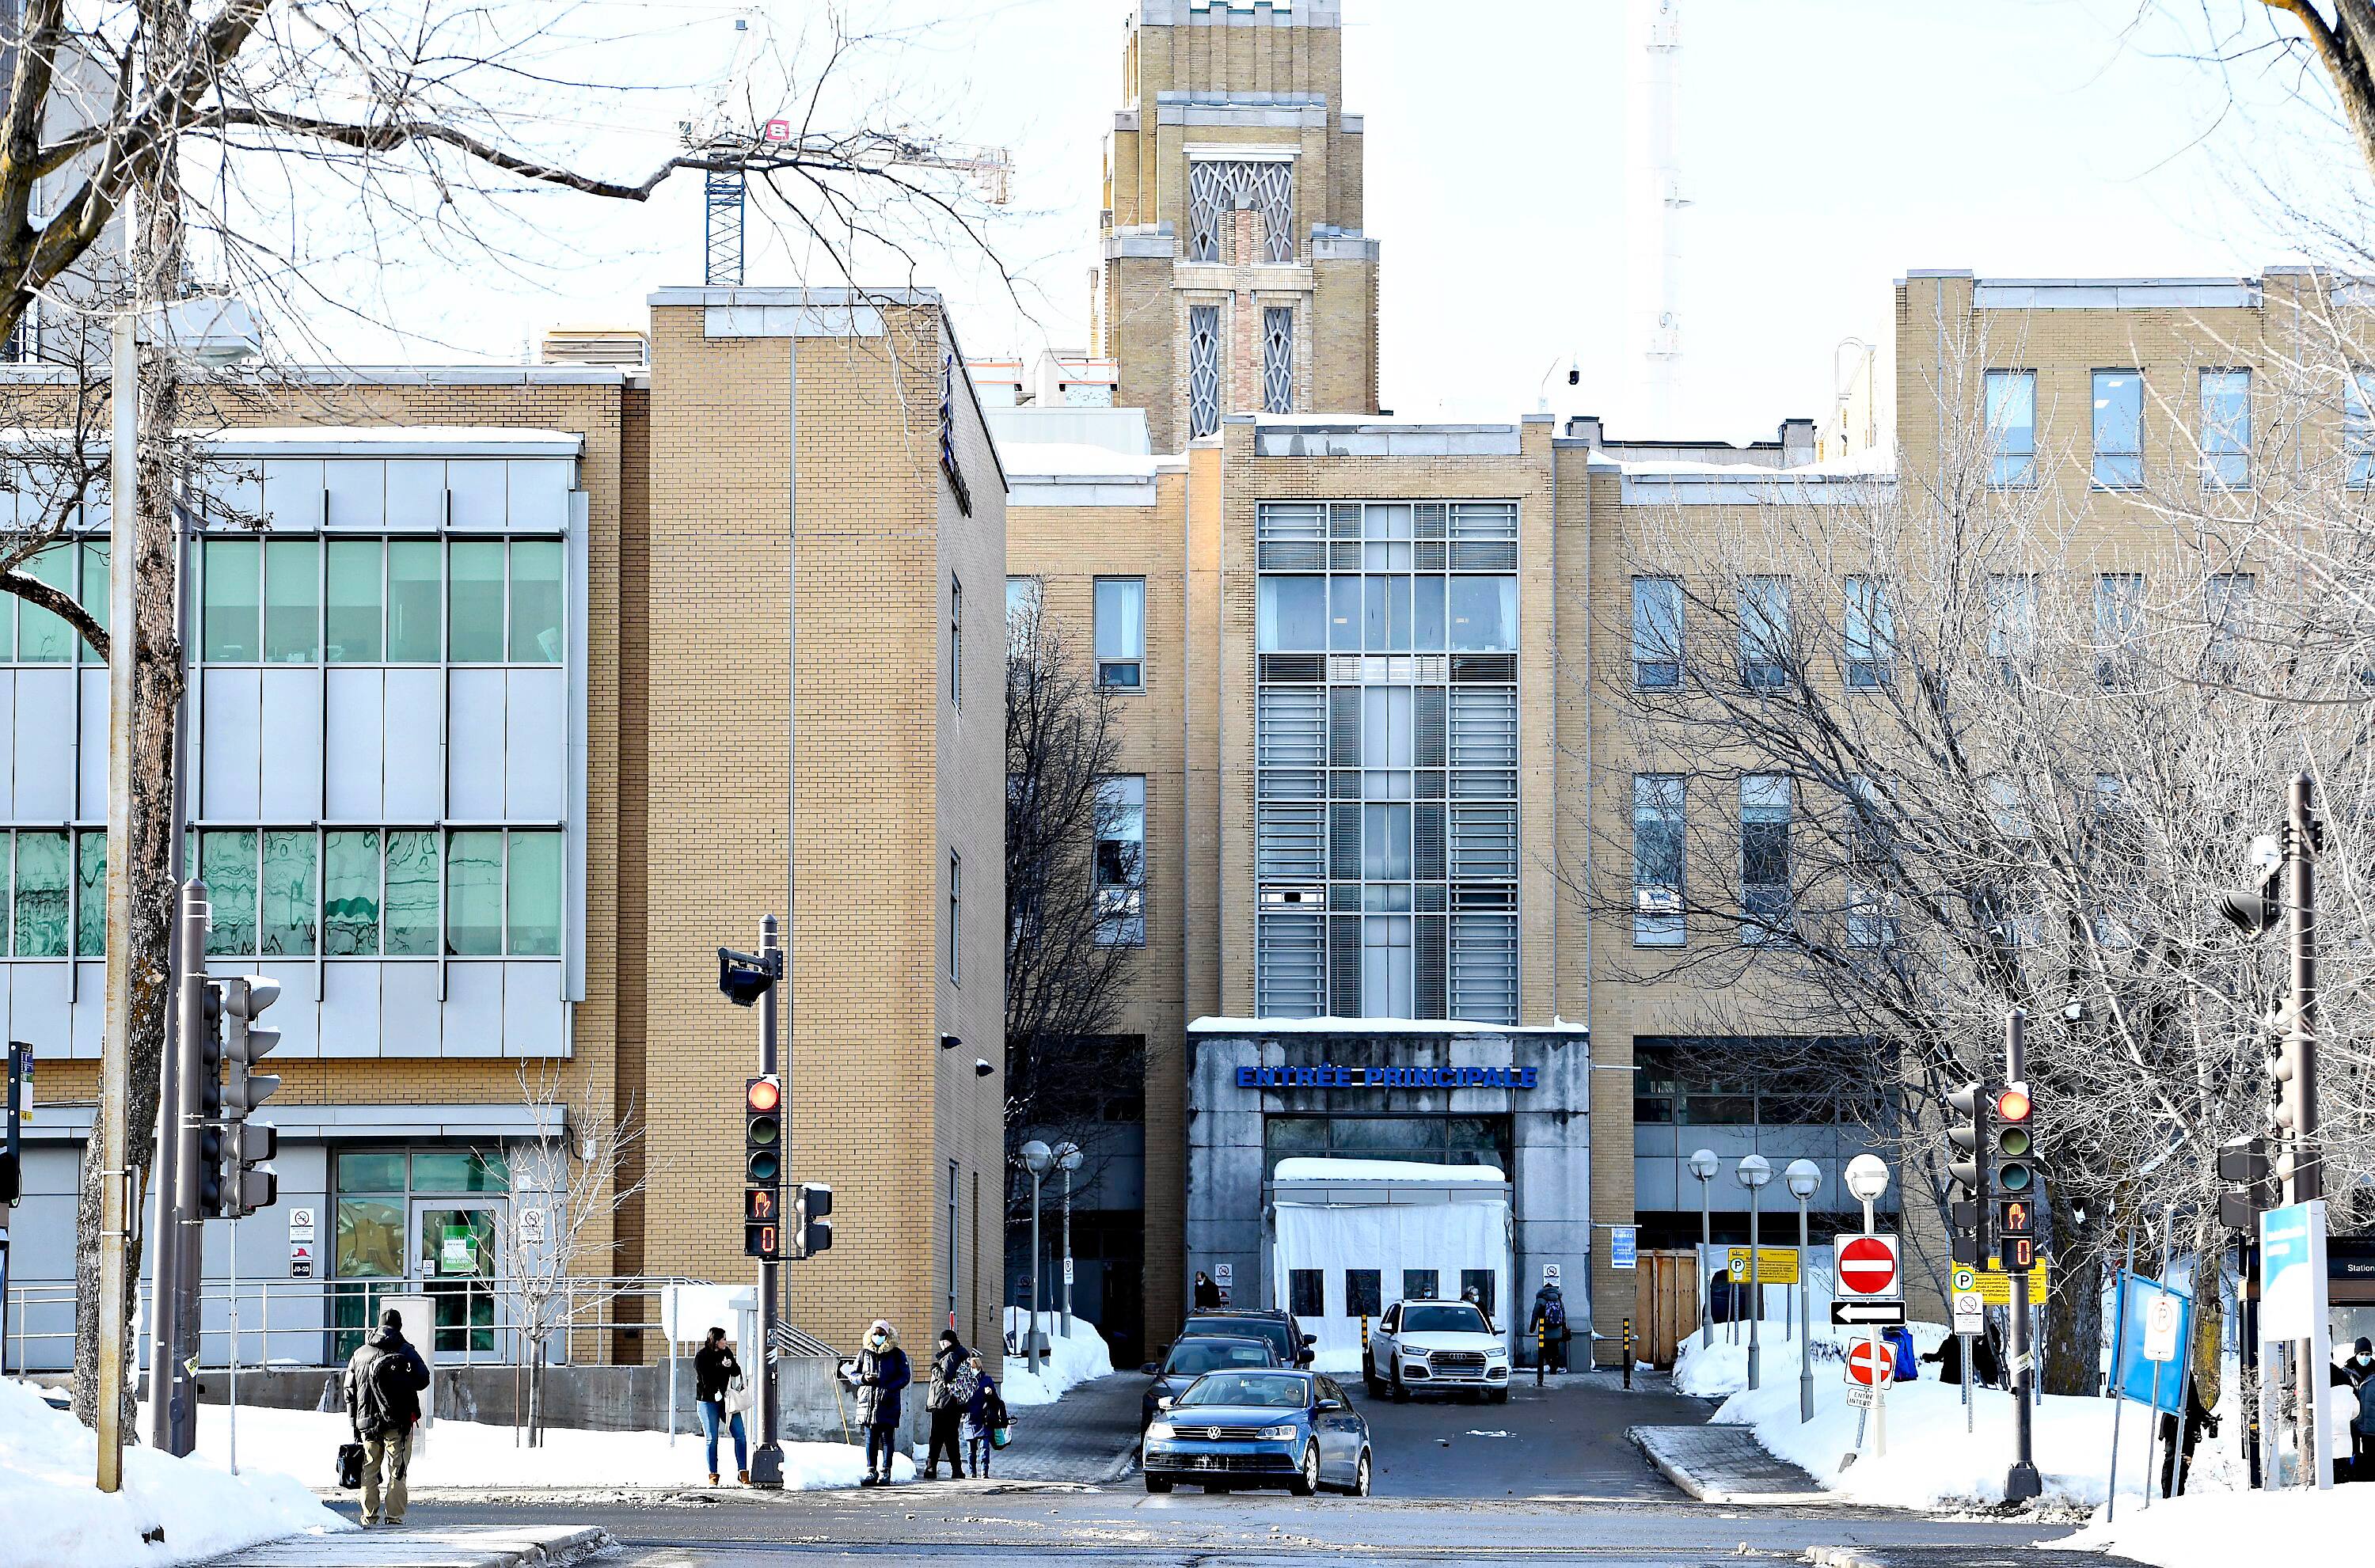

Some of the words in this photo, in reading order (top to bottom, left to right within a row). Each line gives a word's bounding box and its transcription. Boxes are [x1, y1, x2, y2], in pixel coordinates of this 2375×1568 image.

[1237, 1061, 1351, 1087] ENTRÉE
[1365, 1066, 1538, 1088] PRINCIPALE
[762, 1227, 774, 1252] 0
[2017, 1240, 2031, 1265] 0
[1960, 1275, 1969, 1285] P
[1853, 1391, 1874, 1400] ENTRÉ
